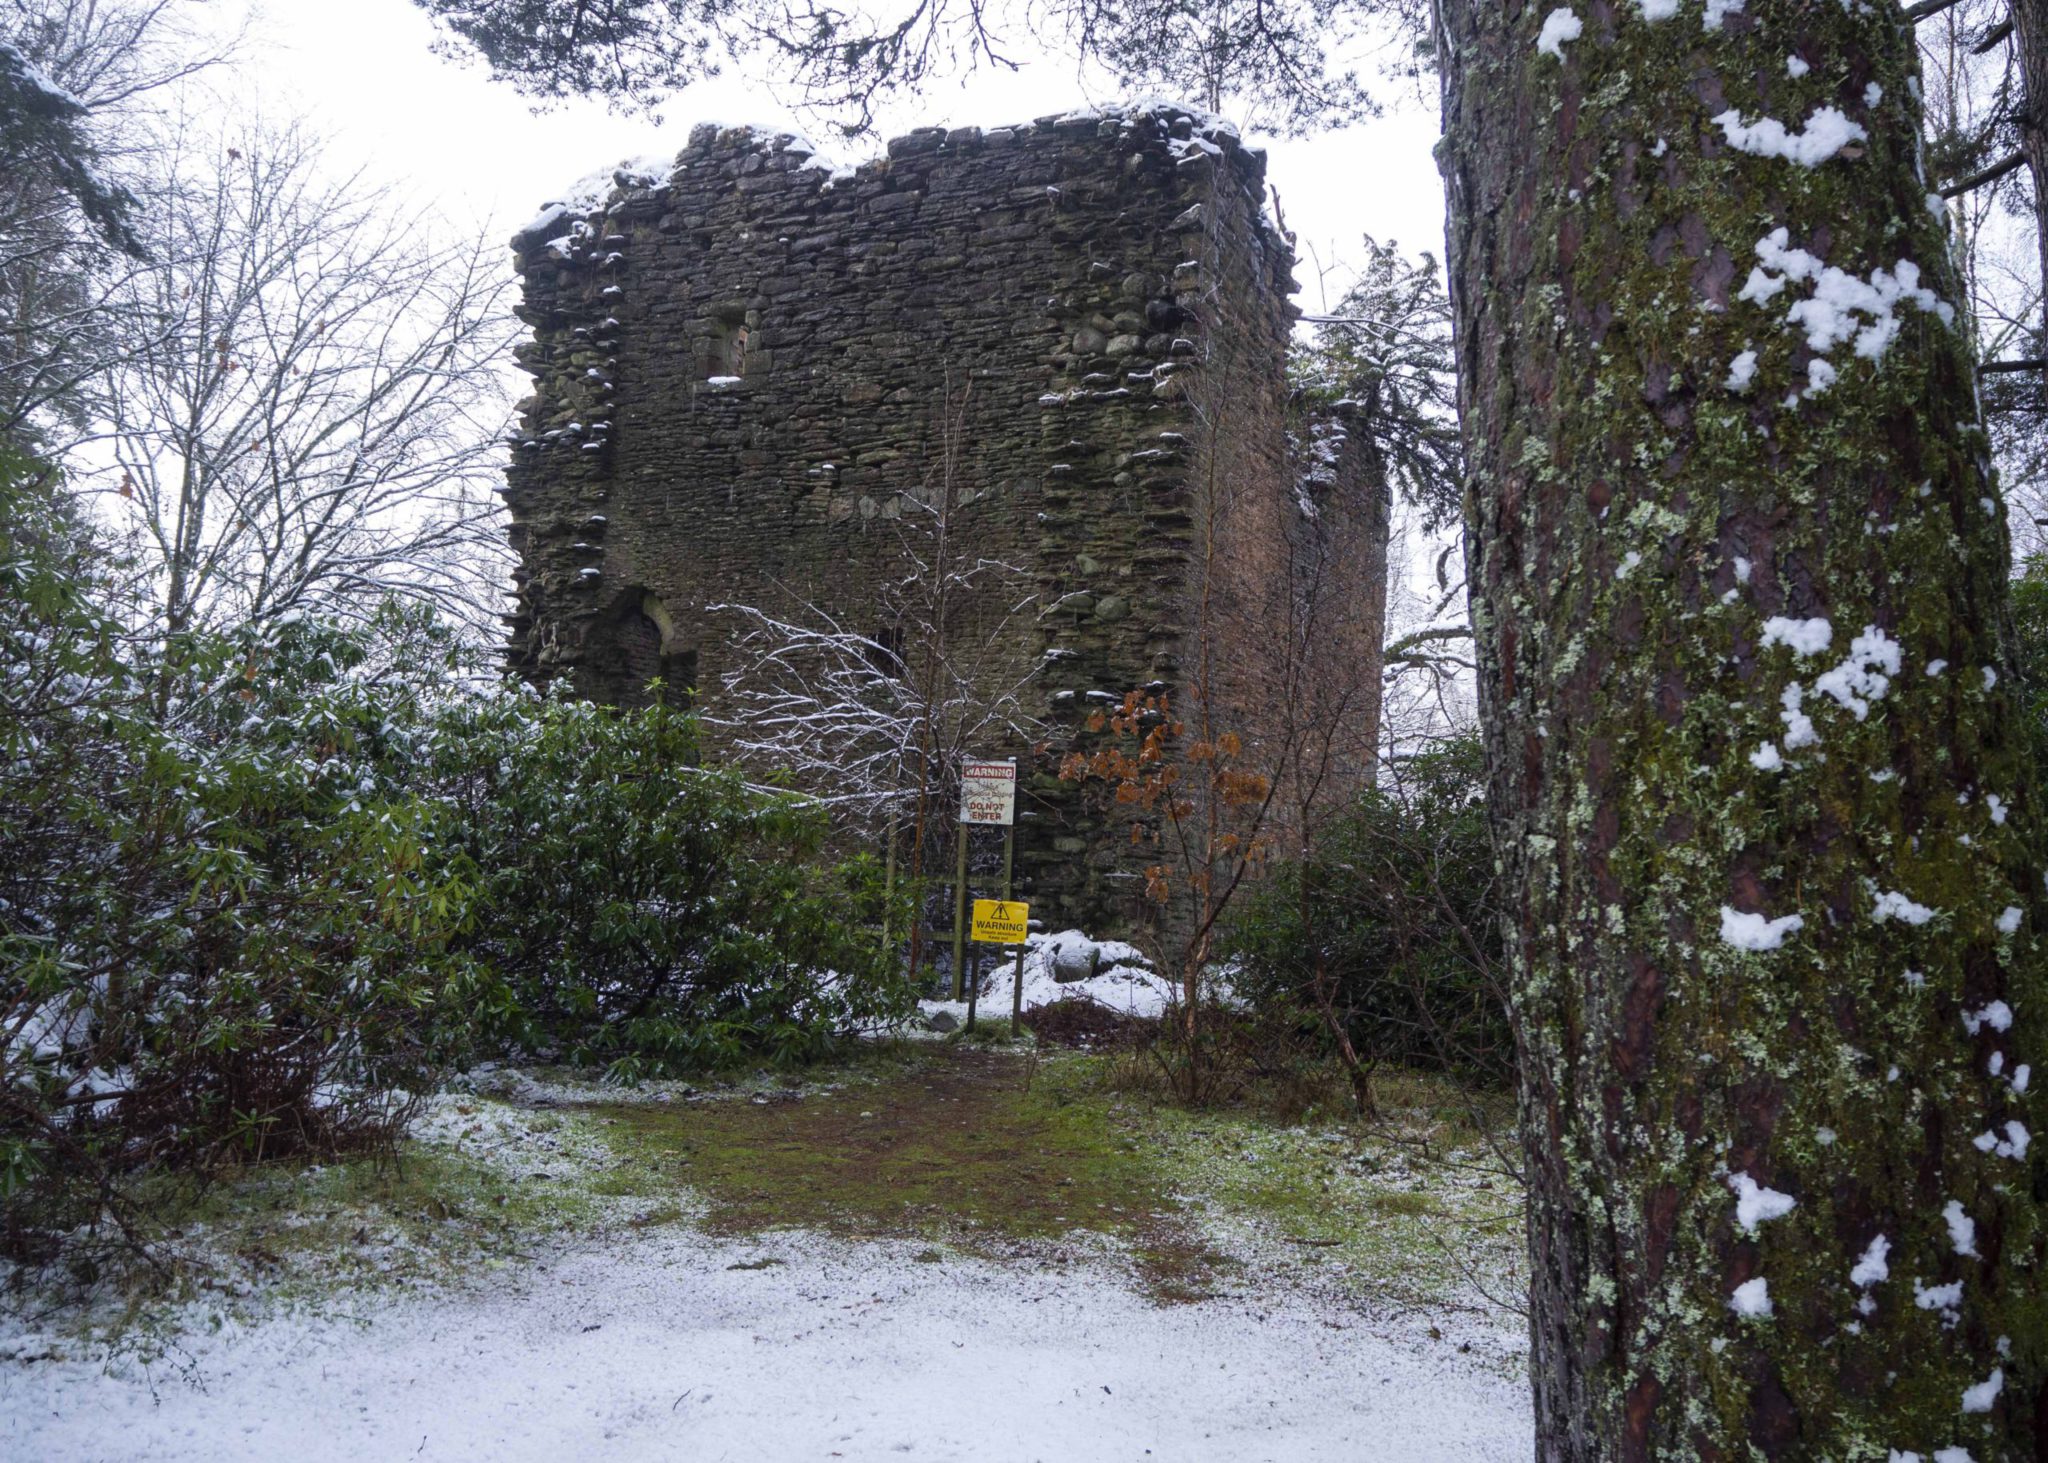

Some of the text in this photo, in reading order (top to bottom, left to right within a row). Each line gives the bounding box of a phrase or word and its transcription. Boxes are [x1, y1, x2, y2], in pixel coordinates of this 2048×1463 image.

[966, 767, 1013, 777] WARNING
[970, 801, 1004, 811] DO NOT
[972, 811, 1001, 820] ENTER
[976, 920, 1023, 932] WARNING
